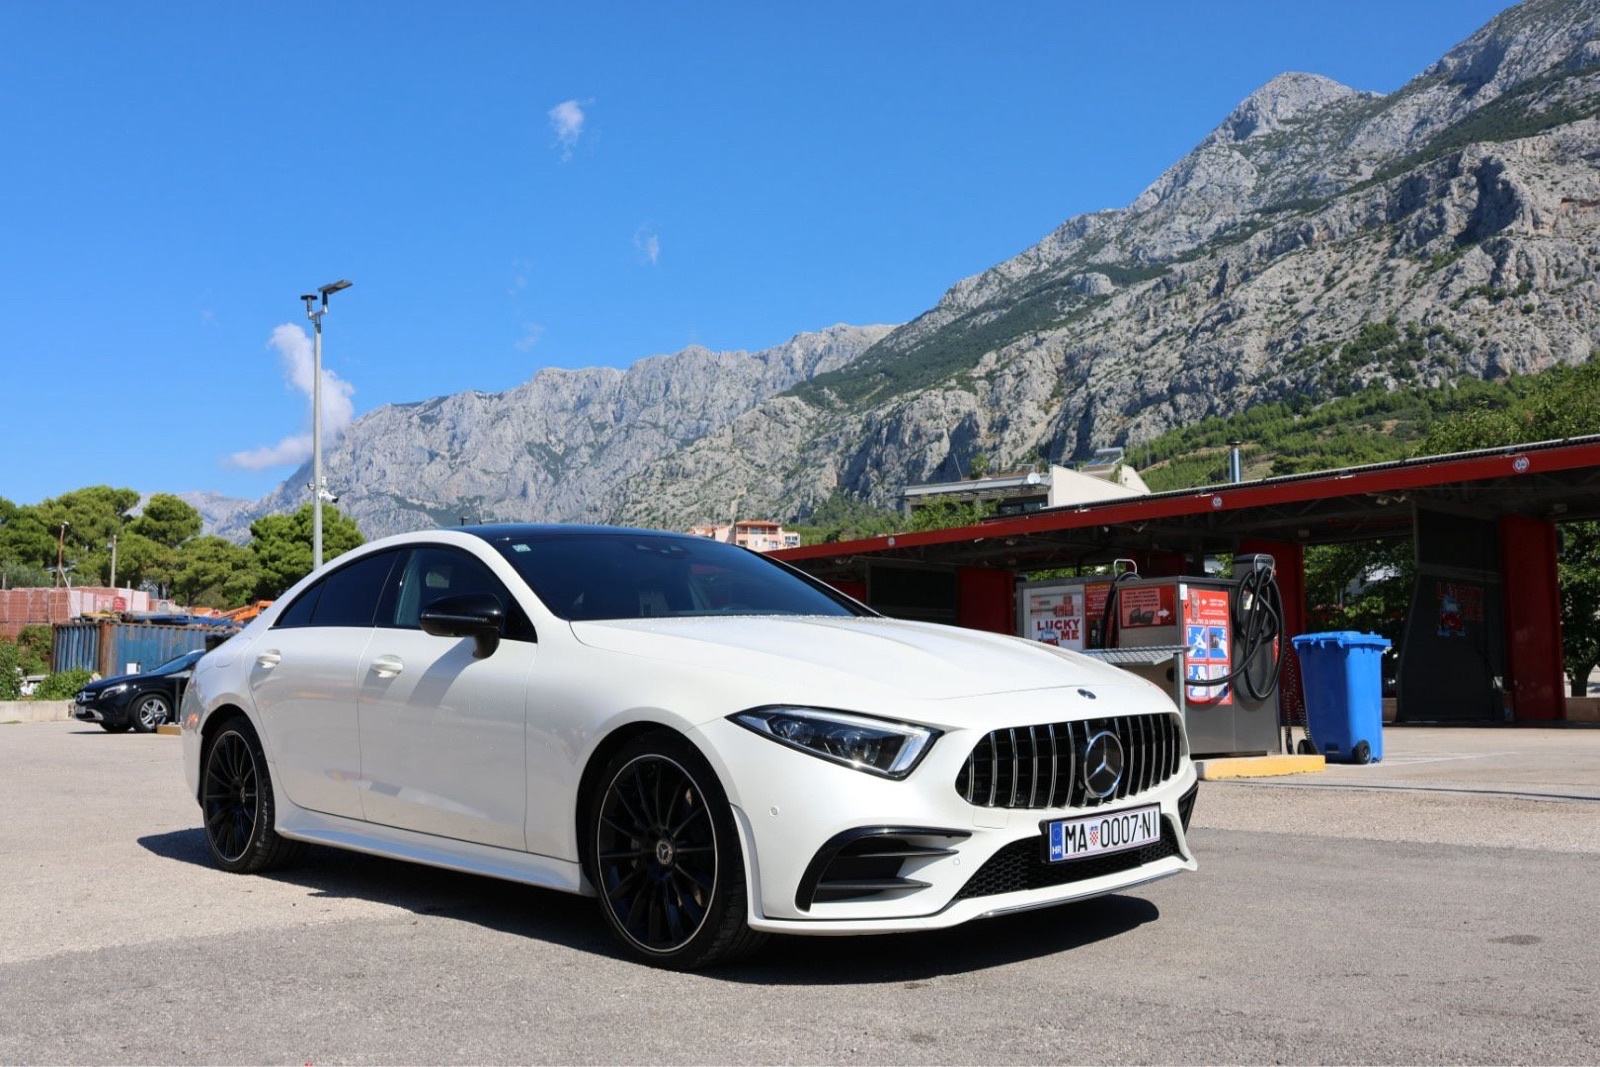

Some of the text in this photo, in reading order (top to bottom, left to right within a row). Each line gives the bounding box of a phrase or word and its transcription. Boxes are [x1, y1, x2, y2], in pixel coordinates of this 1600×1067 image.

[1037, 619, 1080, 631] LUCKY
[1060, 630, 1080, 641] ME
[1065, 823, 1088, 854] MA
